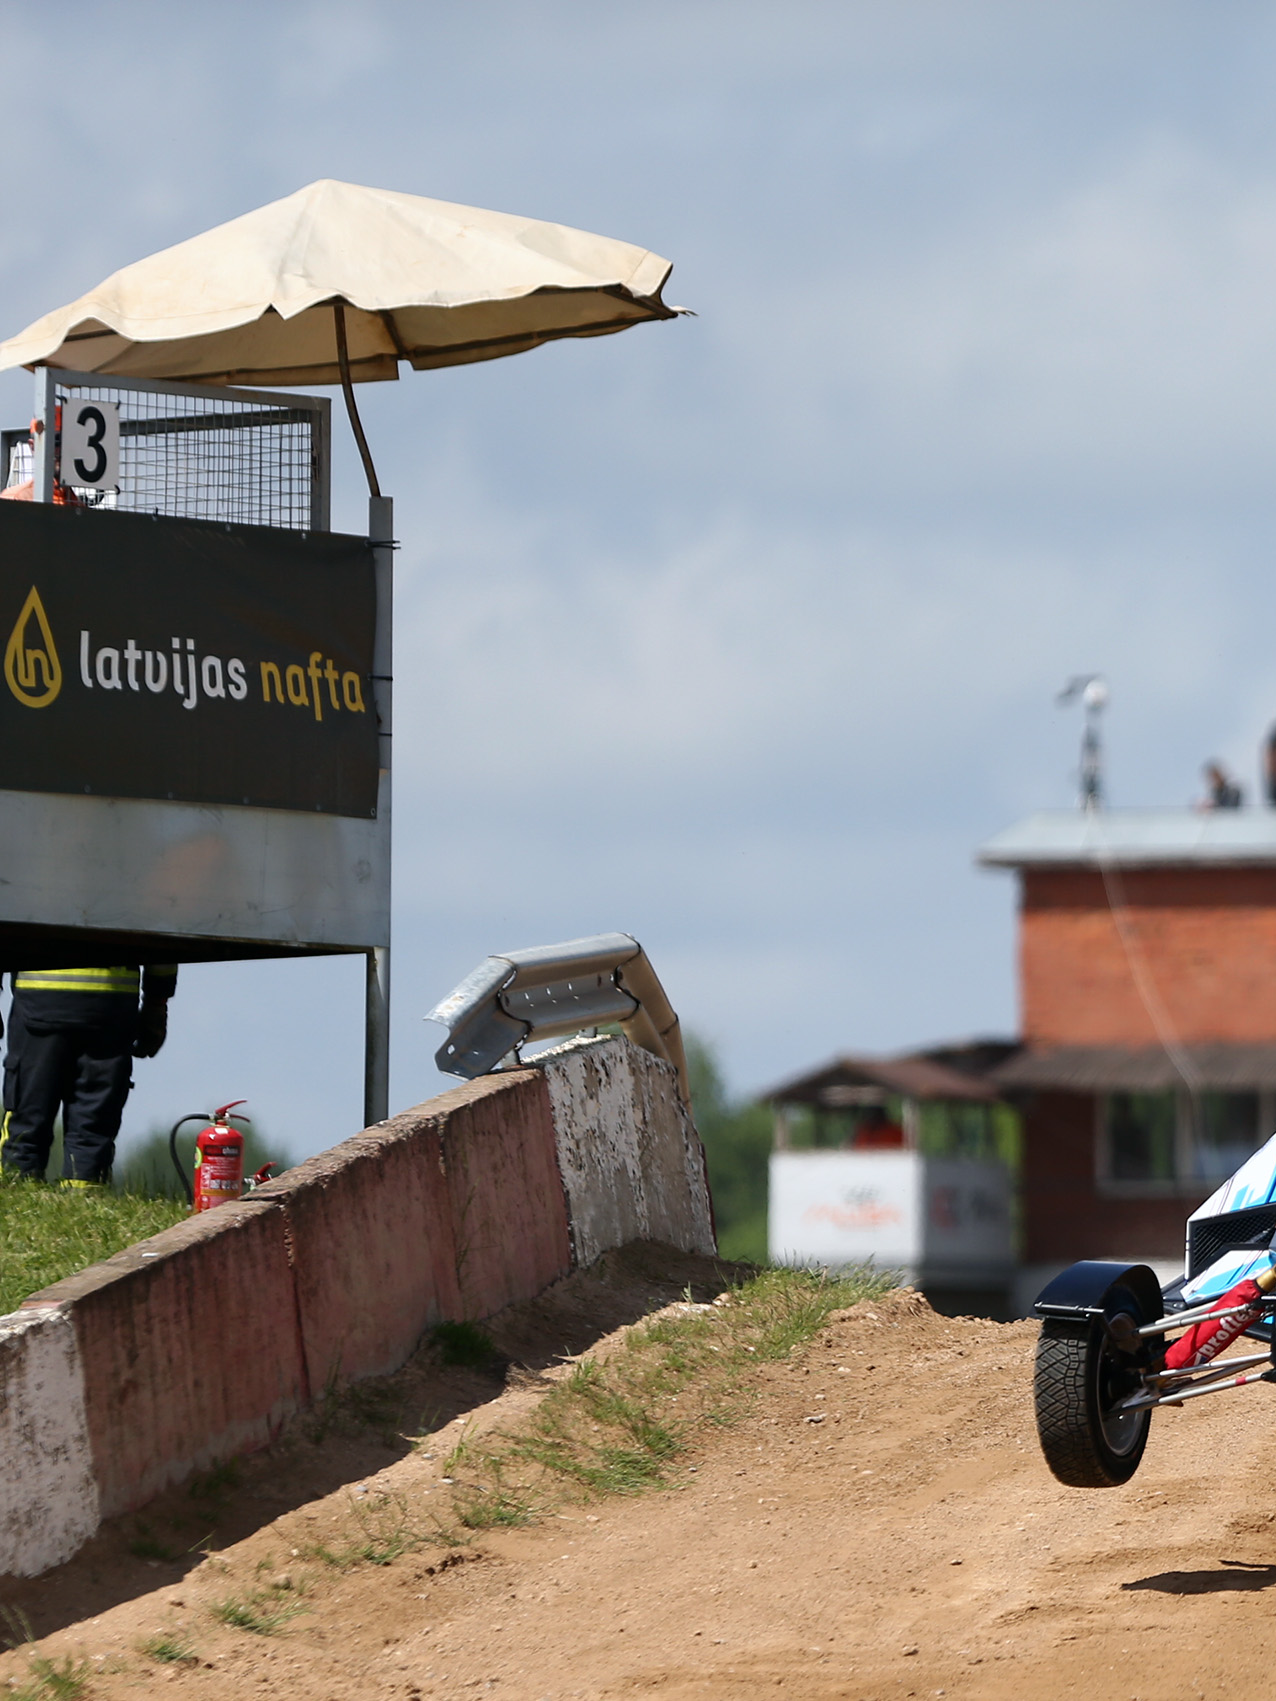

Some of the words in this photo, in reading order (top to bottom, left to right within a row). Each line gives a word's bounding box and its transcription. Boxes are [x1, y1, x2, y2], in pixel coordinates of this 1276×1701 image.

[73, 406, 108, 483] 3
[79, 630, 248, 710] latvijas
[259, 651, 366, 721] nafta
